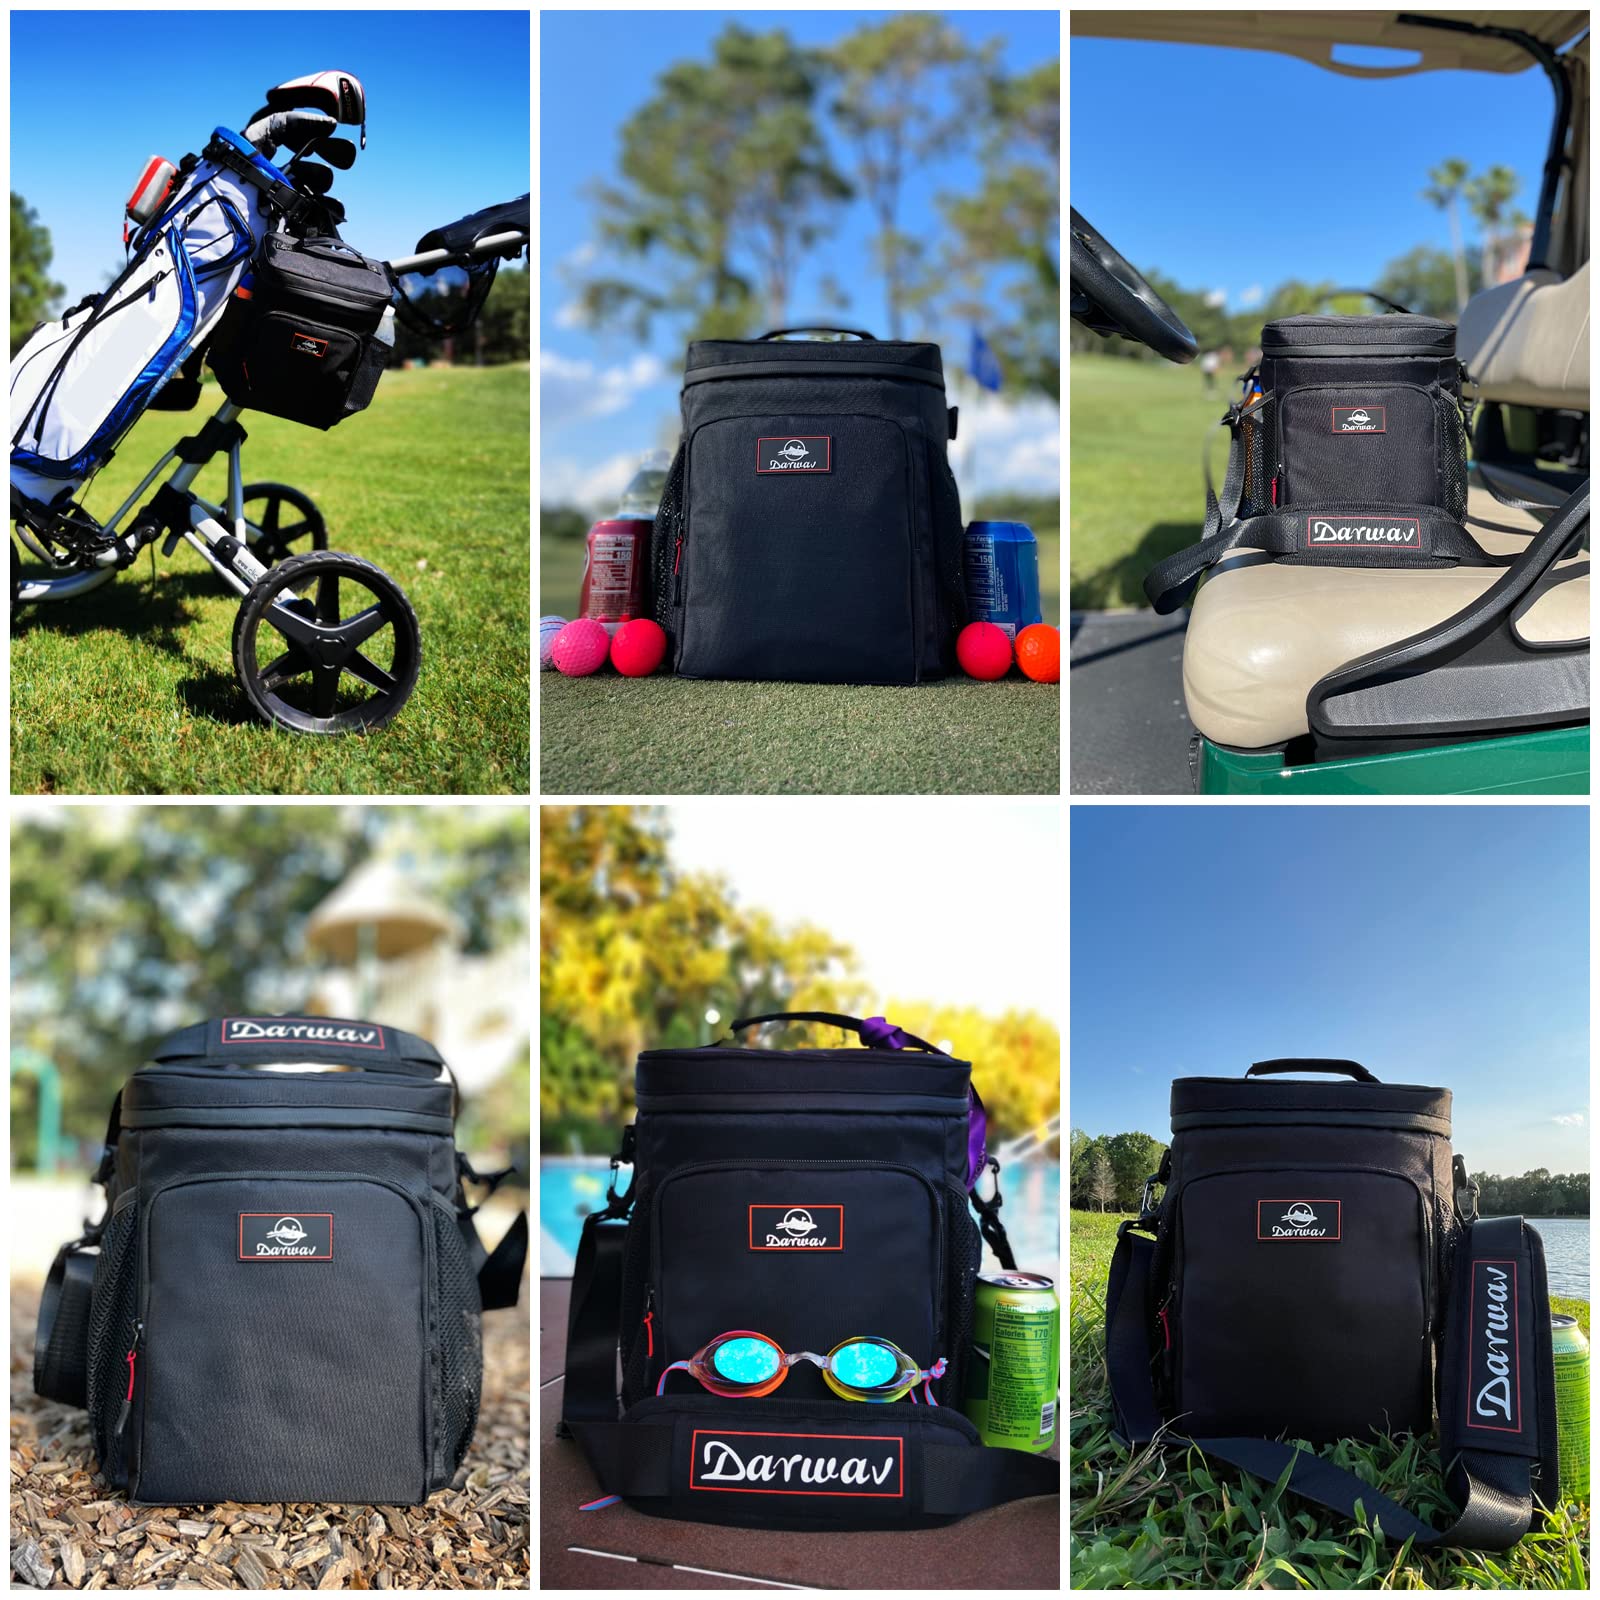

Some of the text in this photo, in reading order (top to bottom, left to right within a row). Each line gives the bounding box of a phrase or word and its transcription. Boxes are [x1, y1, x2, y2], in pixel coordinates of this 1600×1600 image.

[1341, 423, 1377, 431] Darwav
[769, 459, 817, 470] Darwav
[1313, 521, 1415, 542] Darwav
[979, 555, 993, 564] 150
[230, 1021, 376, 1043] Darwav
[1271, 1225, 1326, 1237] Darwav
[765, 1234, 827, 1247] Darwav
[255, 1242, 317, 1256] Darwav
[995, 1327, 1048, 1338] Calories 170
[1476, 1266, 1512, 1421] Darwav
[1557, 1372, 1579, 1380] alories
[700, 1440, 894, 1485] Darwav
